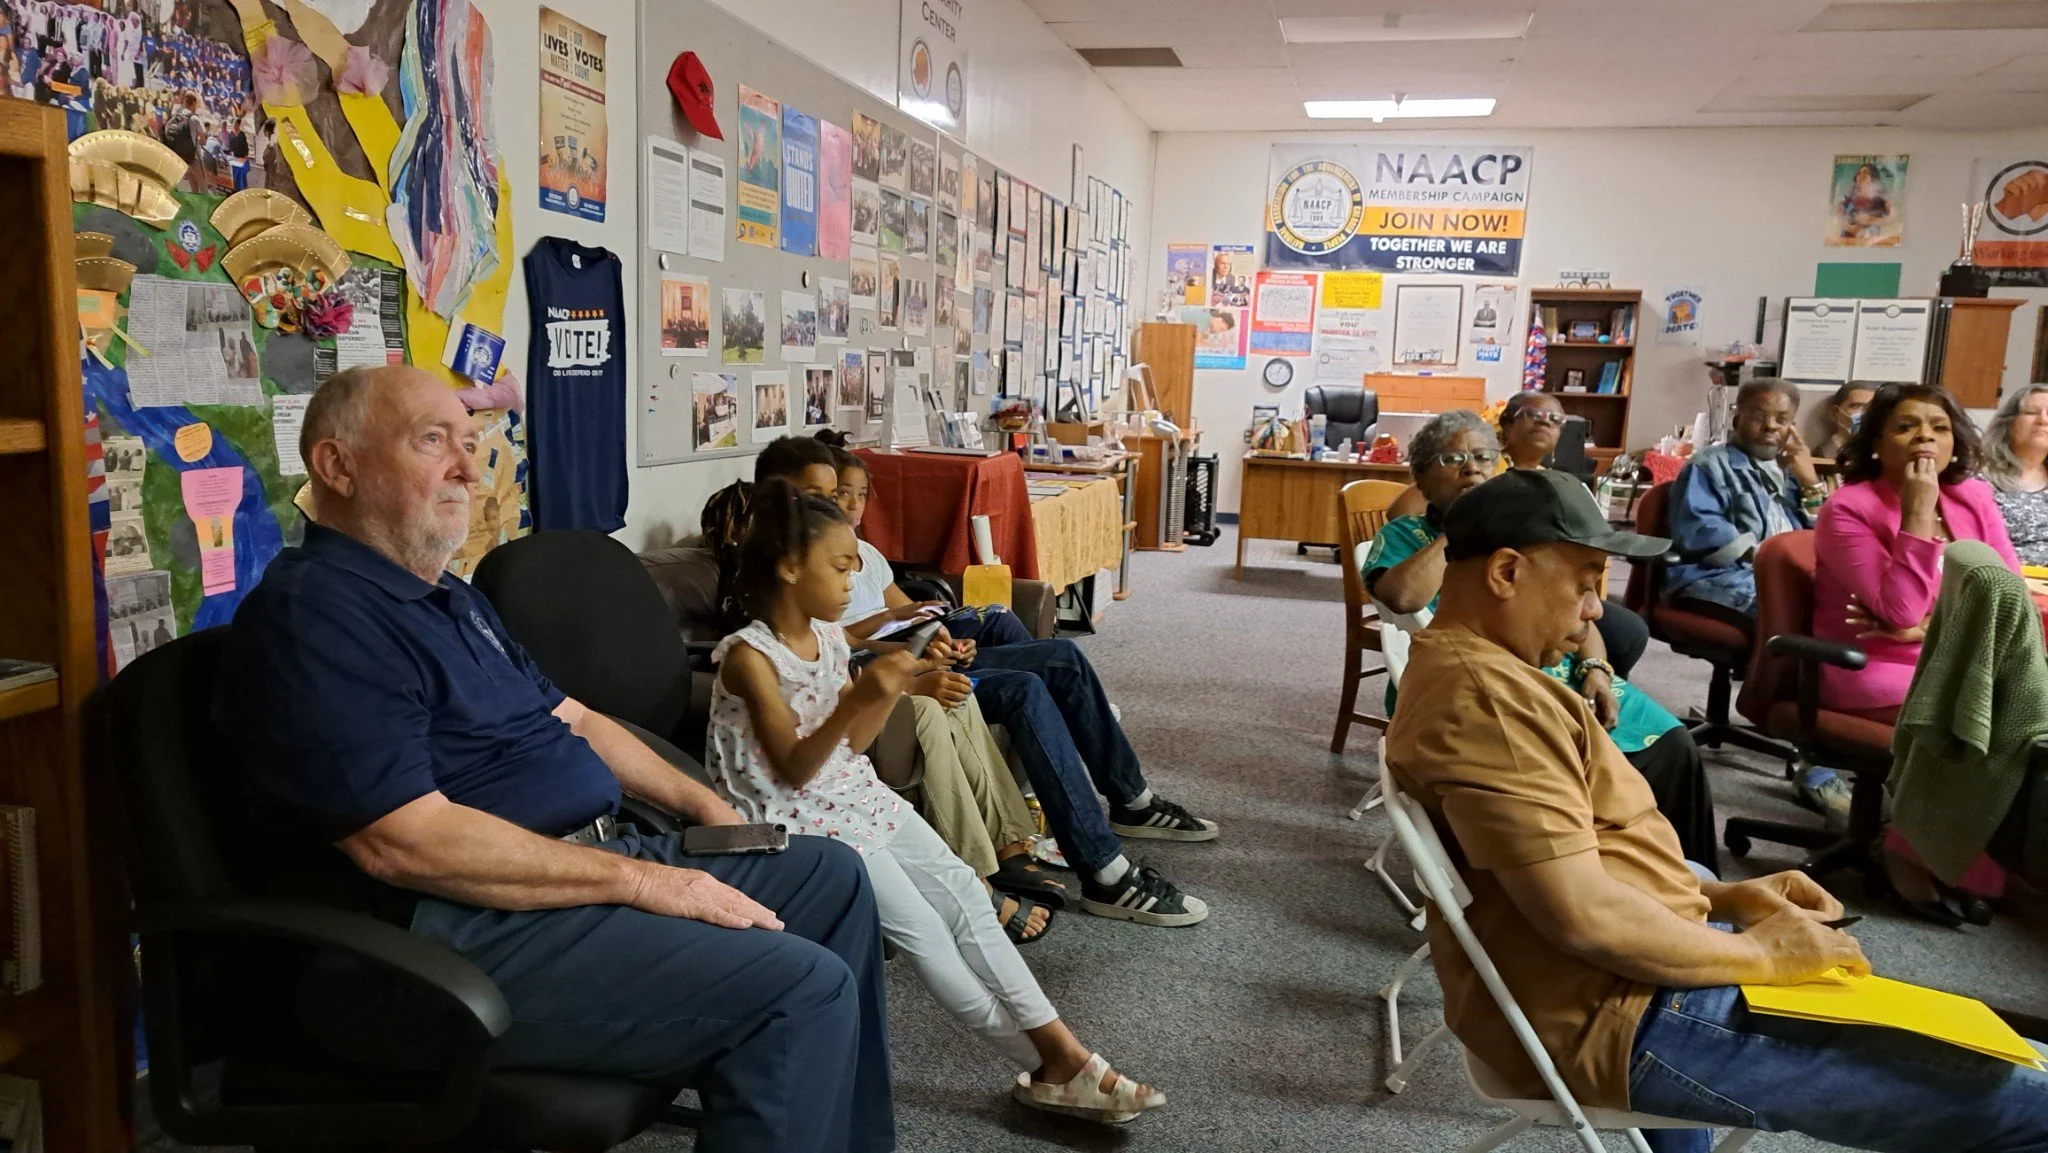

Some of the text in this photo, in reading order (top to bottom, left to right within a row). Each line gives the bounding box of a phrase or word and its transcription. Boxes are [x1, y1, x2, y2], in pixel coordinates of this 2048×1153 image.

[922, 1, 956, 43] CENTER
[544, 32, 569, 57] LIVES
[550, 53, 569, 73] MATTER
[574, 47, 603, 73] VOTES
[1375, 152, 1523, 186] NAACP
[1303, 200, 1332, 210] NAACP
[1368, 189, 1524, 203] MEMBERSHIP CAMPAIGN
[1379, 212, 1508, 233] JOIN NOW!
[1370, 237, 1507, 254] TOGETHER WE ARE
[1396, 256, 1475, 271] STRONGER
